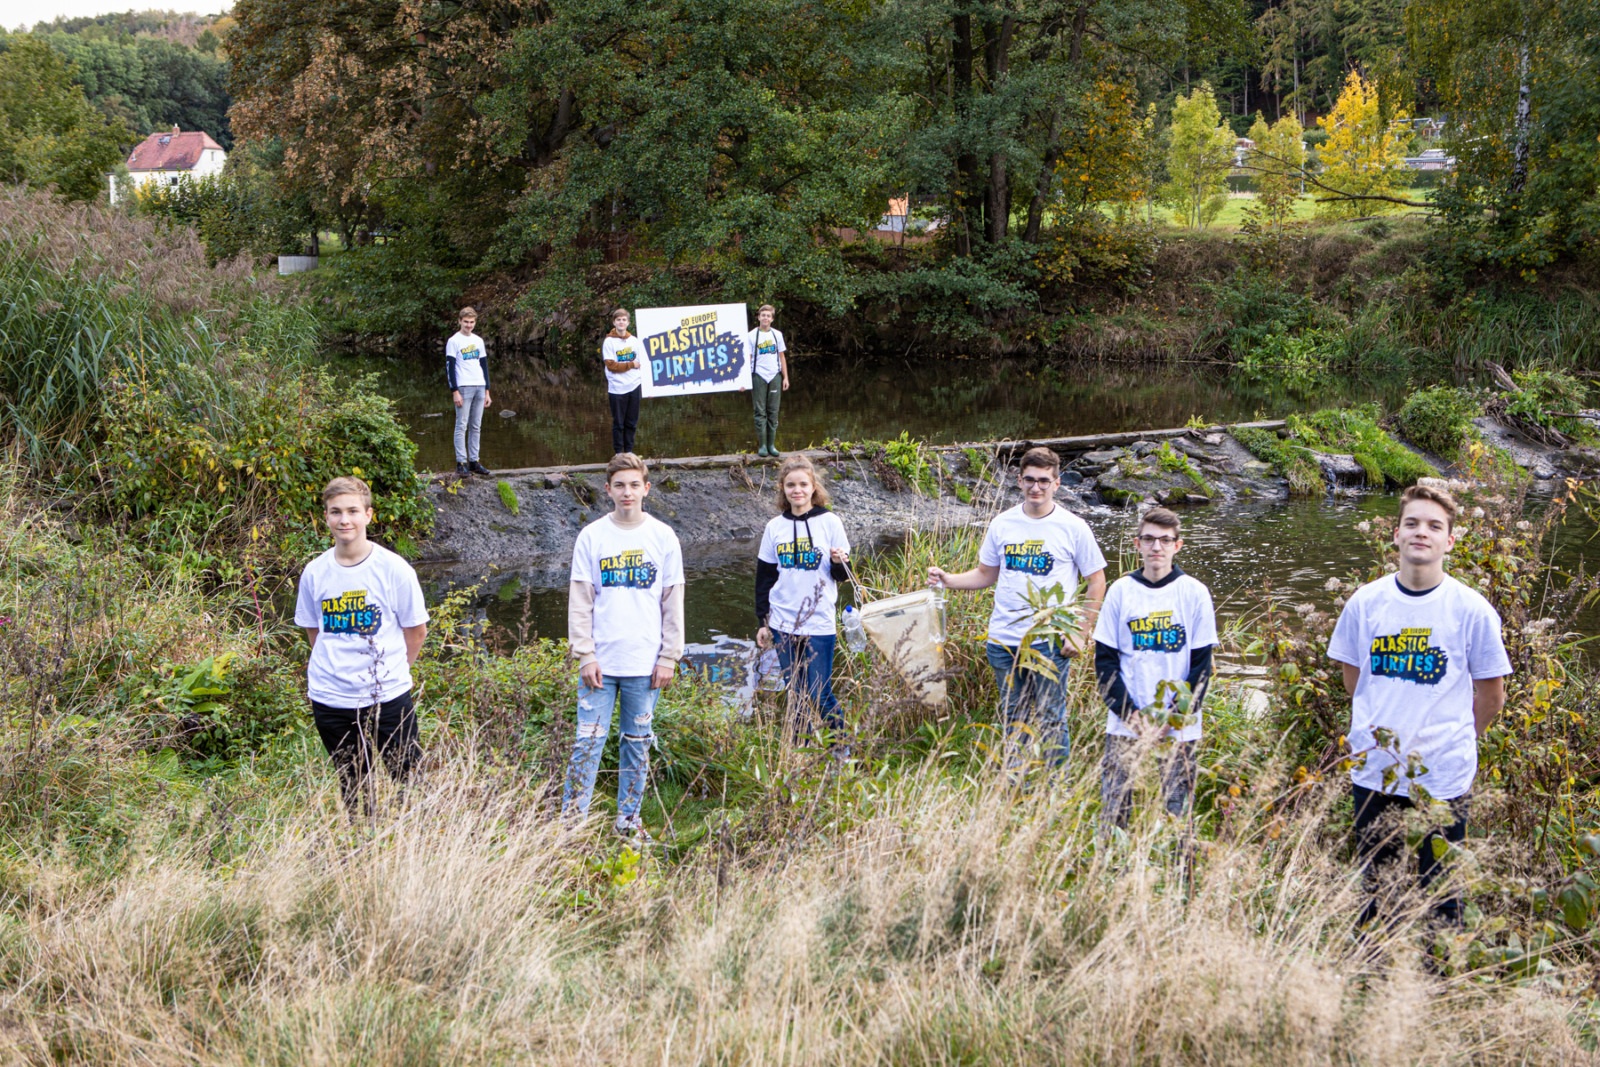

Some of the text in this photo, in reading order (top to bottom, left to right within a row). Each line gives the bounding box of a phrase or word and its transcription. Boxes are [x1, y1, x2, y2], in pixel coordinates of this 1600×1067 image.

[681, 318, 690, 327] GO
[649, 324, 716, 357] PLASTIC
[652, 344, 729, 382] PIRATES
[1005, 544, 1042, 556] PLASTIC
[601, 555, 642, 571] PLASTIC
[322, 597, 365, 613] PLASTIC
[1130, 617, 1171, 633] PLASTIC
[1371, 636, 1427, 653] PLASTIC
